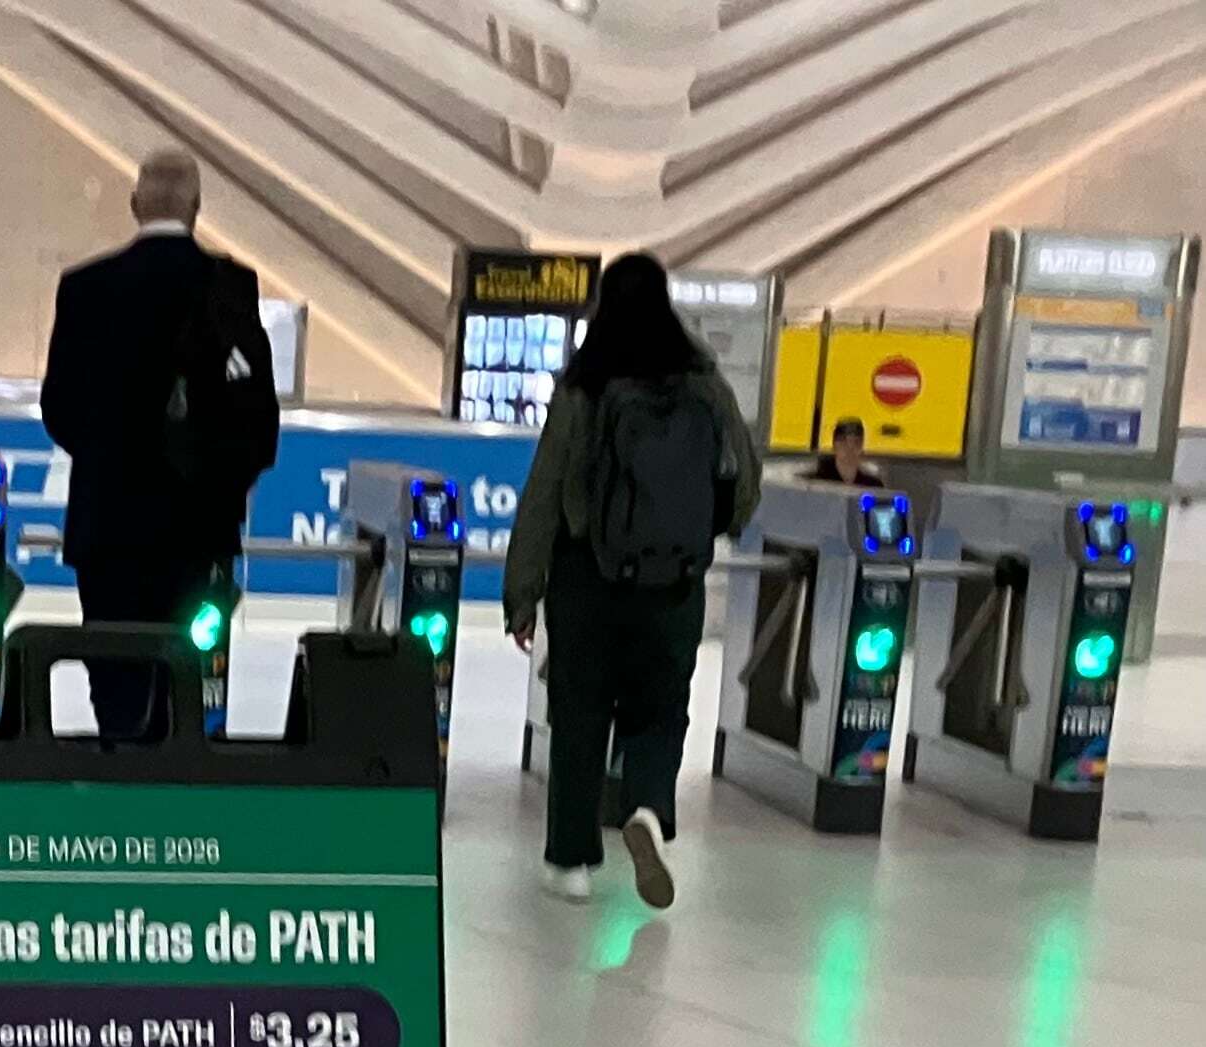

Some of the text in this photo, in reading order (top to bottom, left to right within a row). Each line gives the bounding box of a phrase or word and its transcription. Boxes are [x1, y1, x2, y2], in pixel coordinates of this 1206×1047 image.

[8, 834, 41, 863] DE
[48, 835, 117, 864] MAYO
[125, 836, 156, 865] DE
[164, 836, 220, 865] 2026
[51, 906, 194, 964] tarifas
[205, 907, 257, 965] de
[269, 909, 376, 965] PATH
[100, 1018, 133, 1047] de
